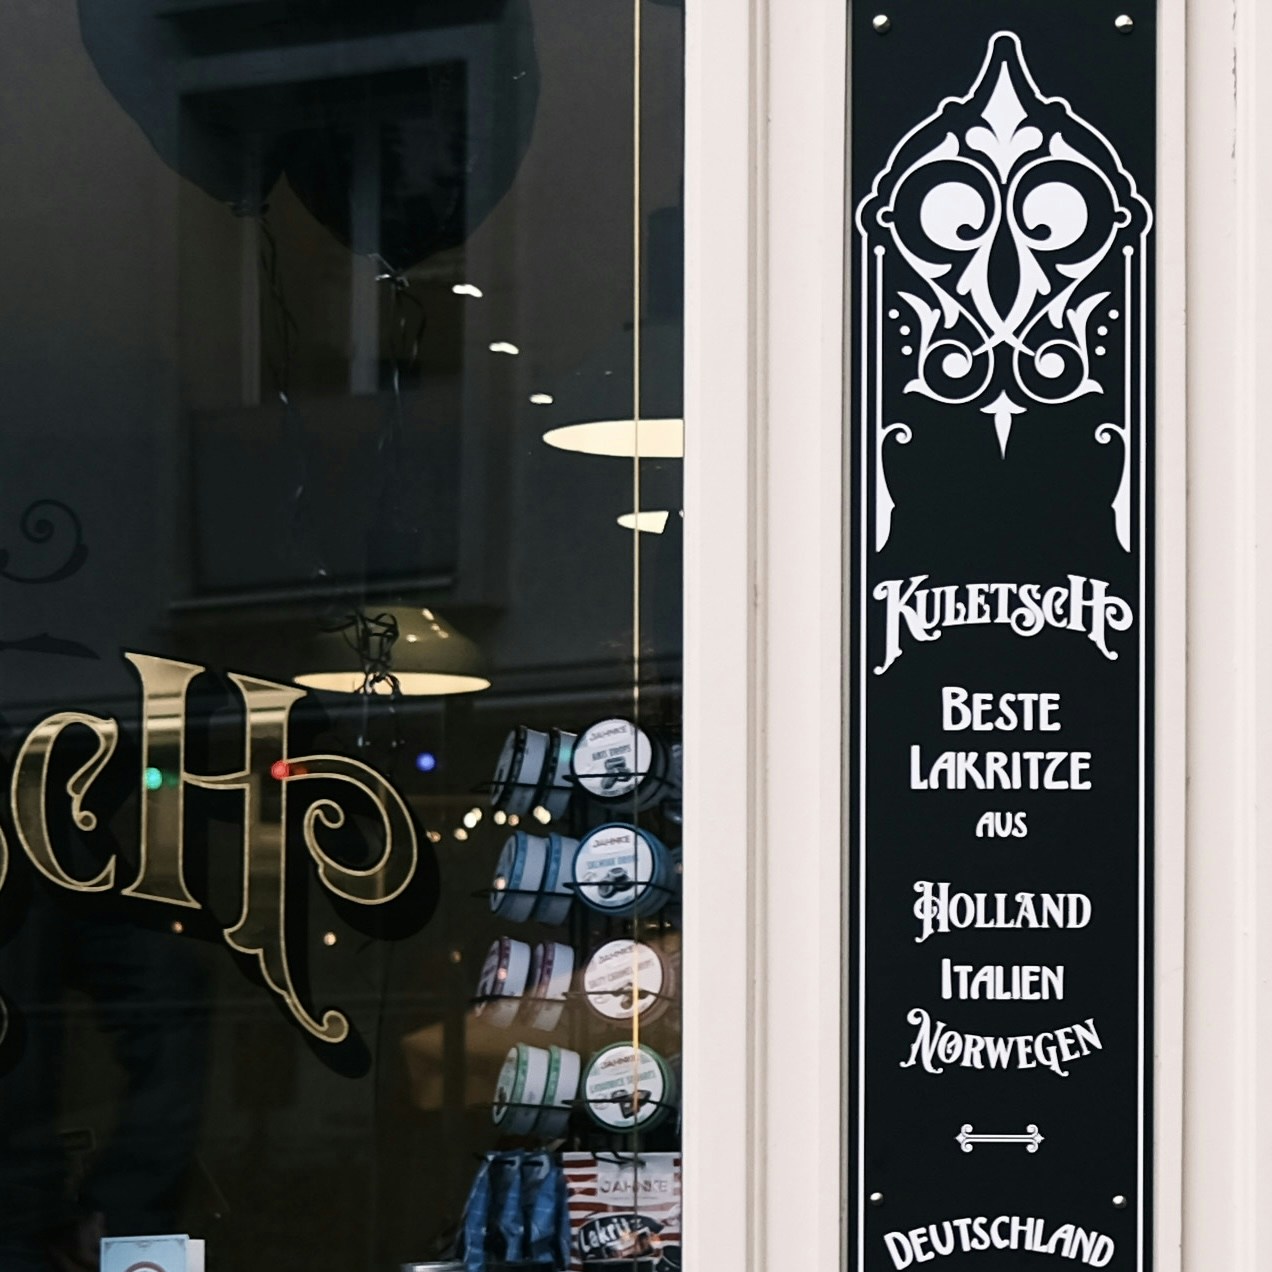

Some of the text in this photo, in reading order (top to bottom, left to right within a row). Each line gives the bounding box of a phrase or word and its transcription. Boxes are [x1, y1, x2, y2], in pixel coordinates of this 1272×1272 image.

[873, 575, 1133, 675] KULETSCH
[942, 687, 1061, 731] BESTE
[911, 745, 1091, 789] LAKRITZE
[976, 812, 1027, 837] AUS
[914, 881, 1091, 943] HOLLAND
[942, 958, 1064, 1000] ITALIEN
[900, 1008, 1102, 1076] NORWEGEN
[884, 1216, 1115, 1270] DEUTSCHLAND
